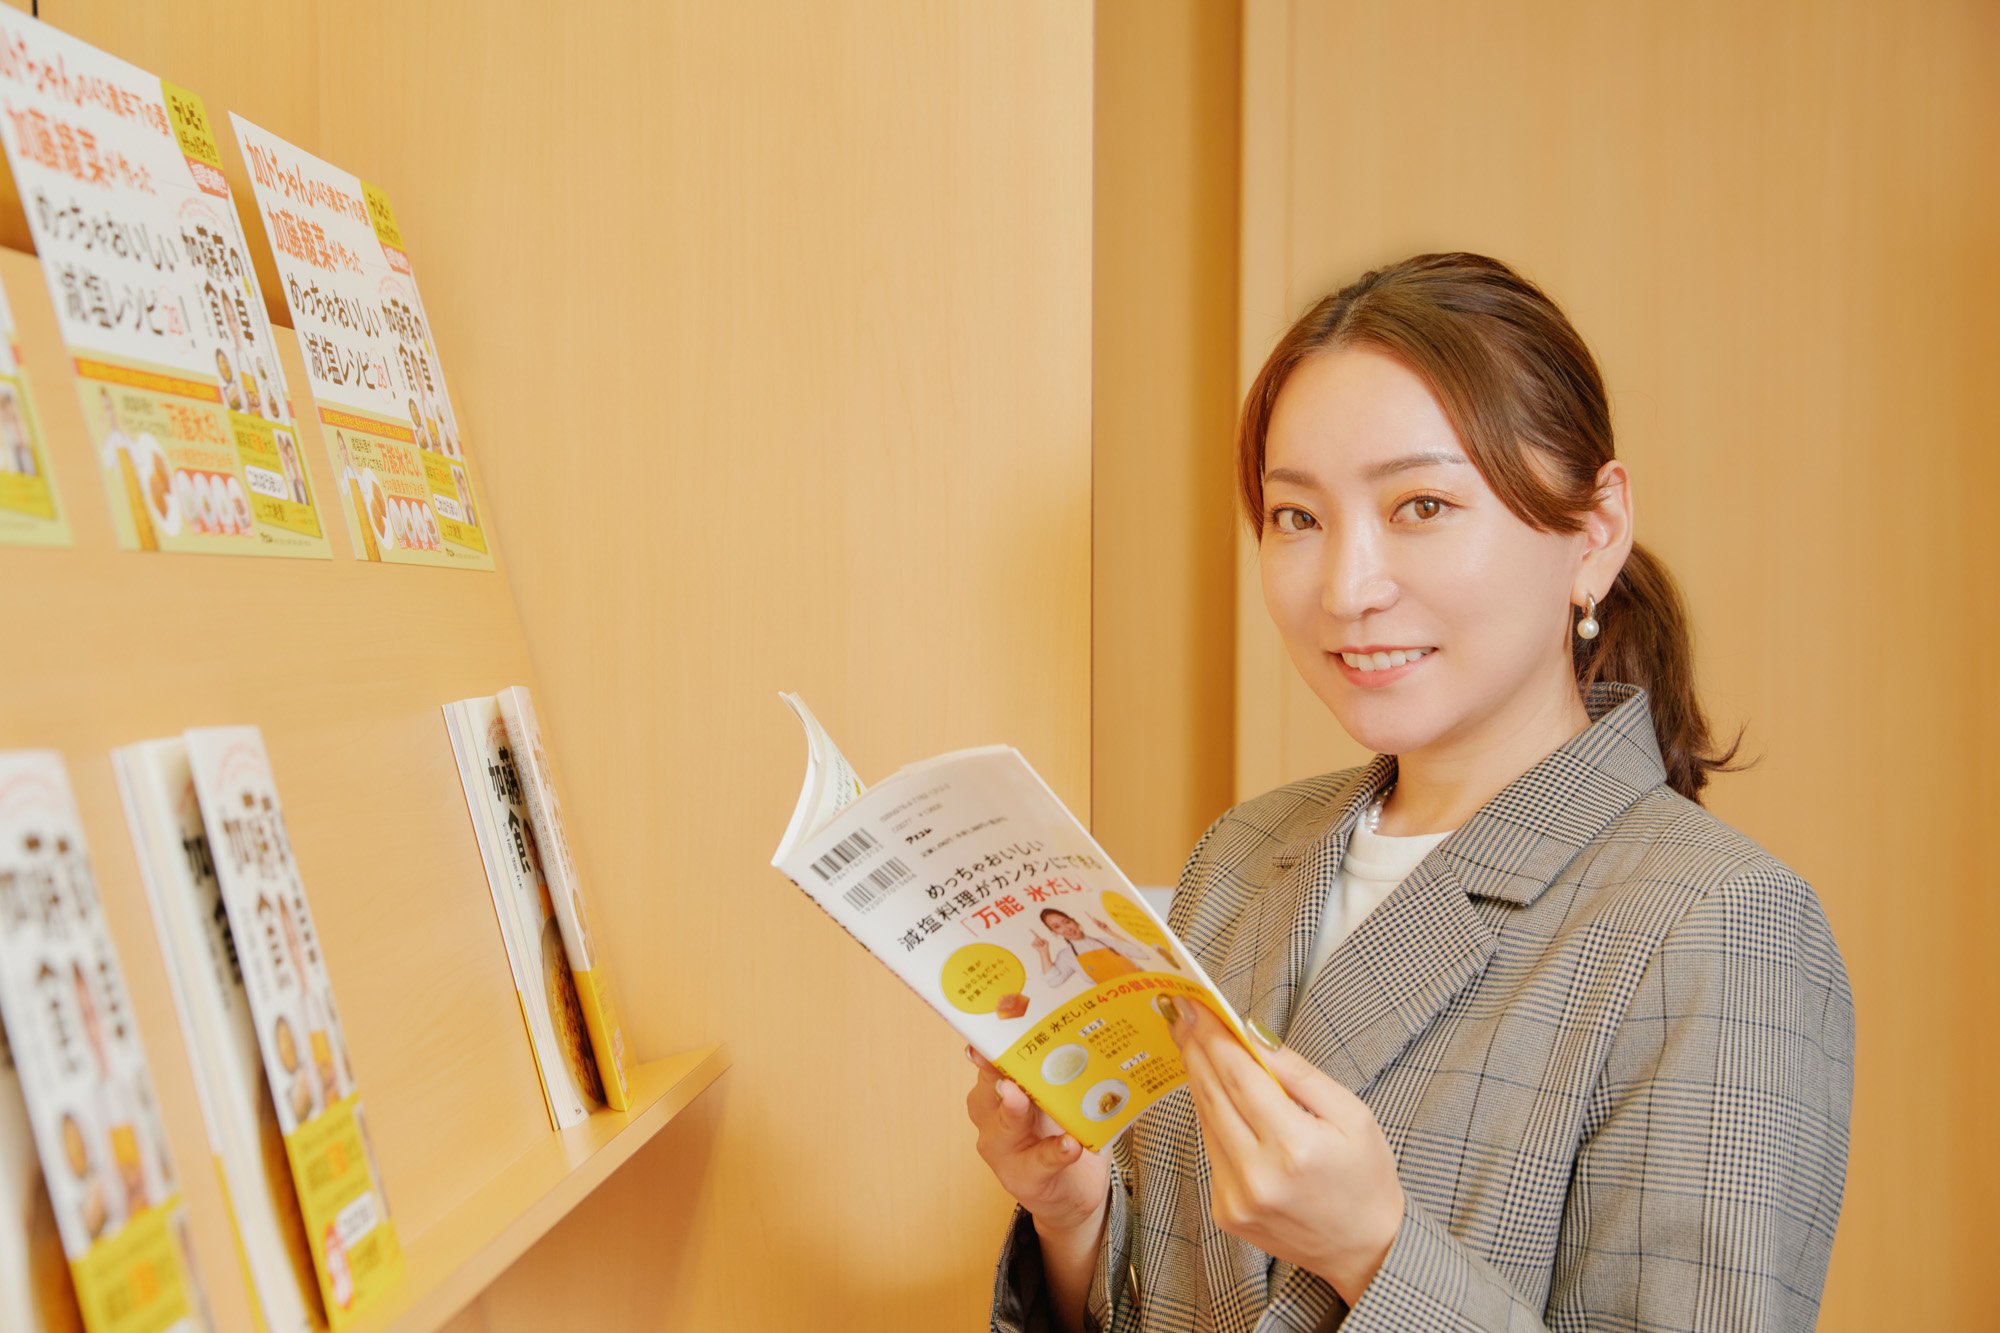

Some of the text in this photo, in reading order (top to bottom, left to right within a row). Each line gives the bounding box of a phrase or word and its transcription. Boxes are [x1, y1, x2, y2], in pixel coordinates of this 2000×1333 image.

[33, 186, 180, 273] めっちゃおいしい
[267, 201, 365, 275] 加藤綾菜が作った
[286, 273, 381, 338] めっちゃおいしい
[897, 854, 1104, 952] 減塩料理がカンタンにできる
[925, 839, 1044, 900] めっちゃおいしい
